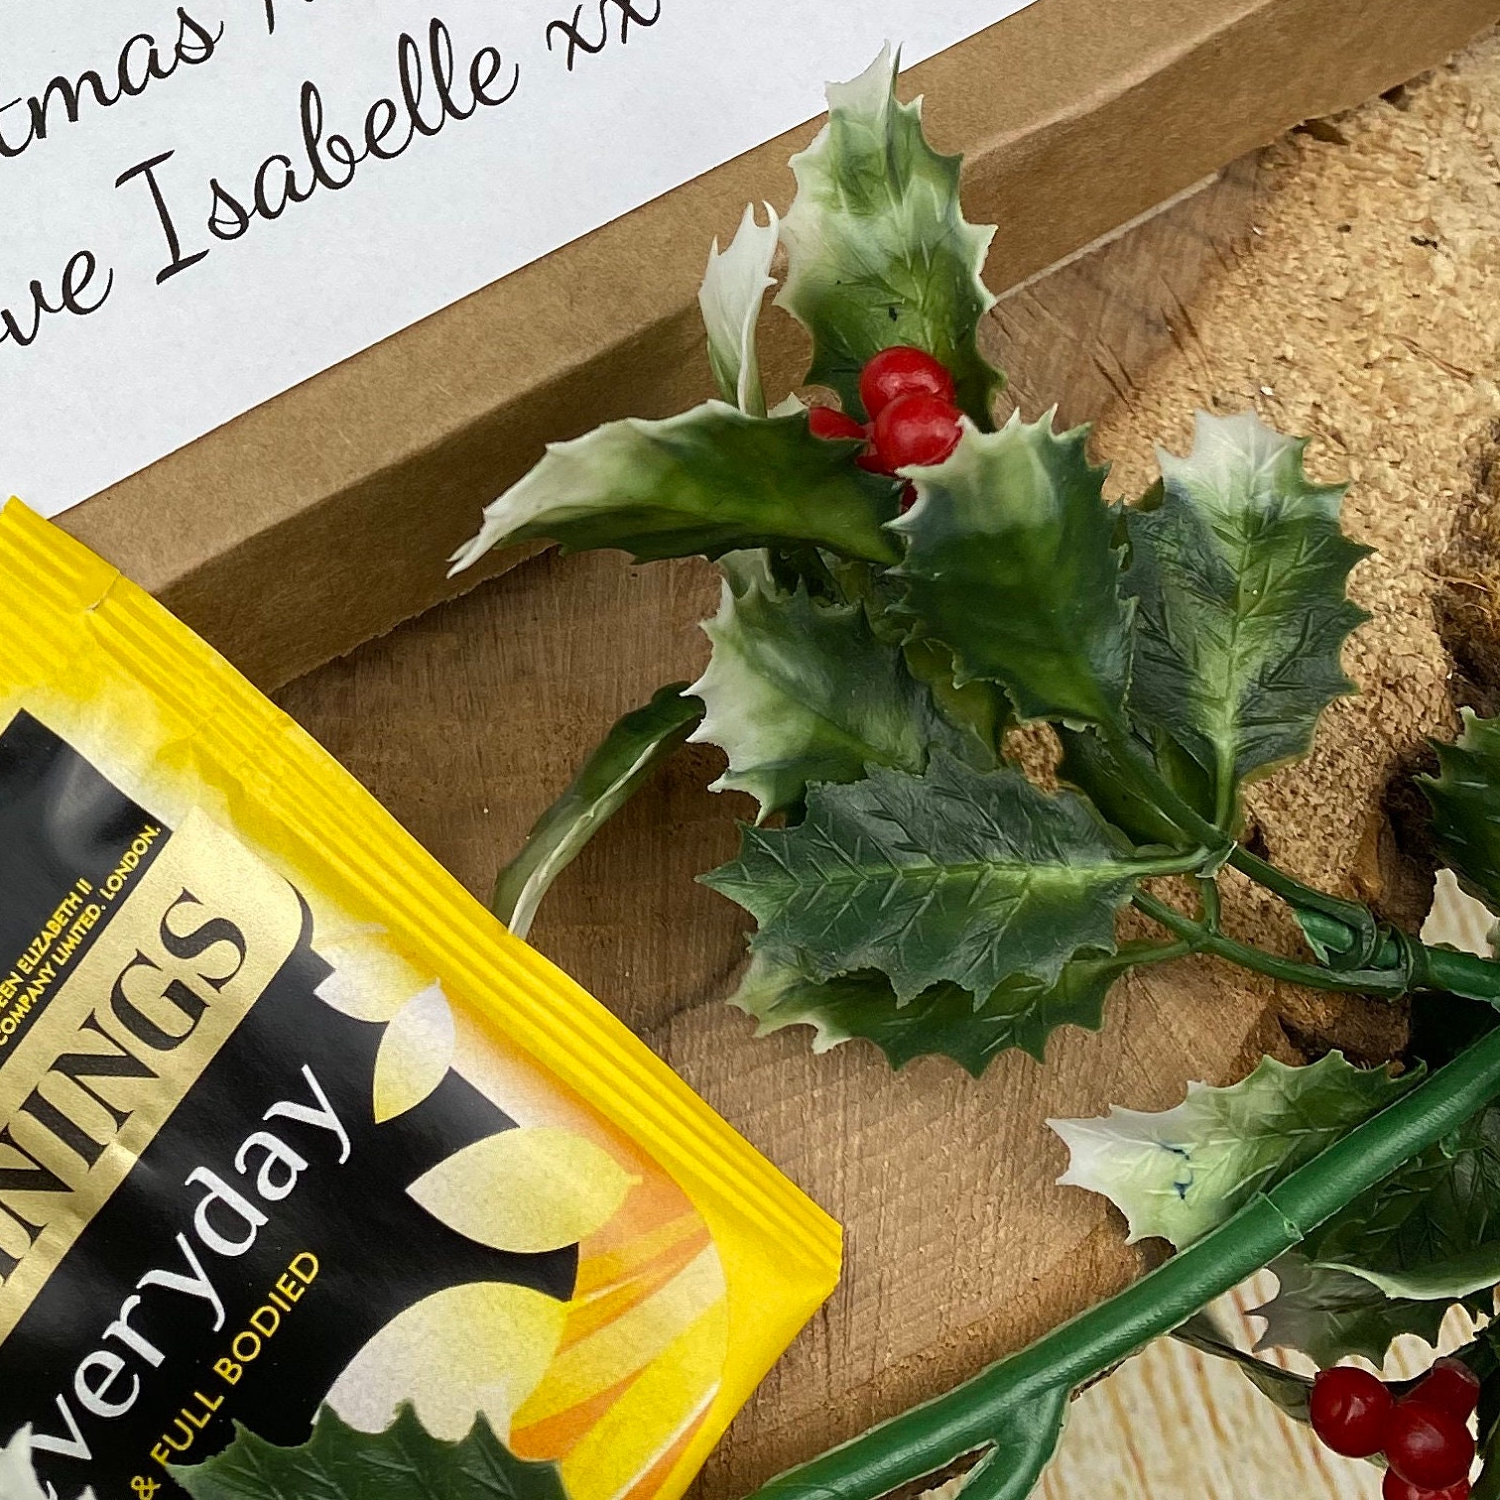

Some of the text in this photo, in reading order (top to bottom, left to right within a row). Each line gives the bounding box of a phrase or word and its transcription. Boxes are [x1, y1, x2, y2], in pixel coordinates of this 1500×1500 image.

[114, 18, 520, 285] Isabelle
[16, 891, 84, 974] ELIZABETH
[77, 877, 93, 895] II
[51, 902, 106, 966] LIMITED.
[99, 824, 161, 901] LONDON.
[150, 1390, 225, 1466] FULL
[213, 1250, 321, 1385] BODIED
